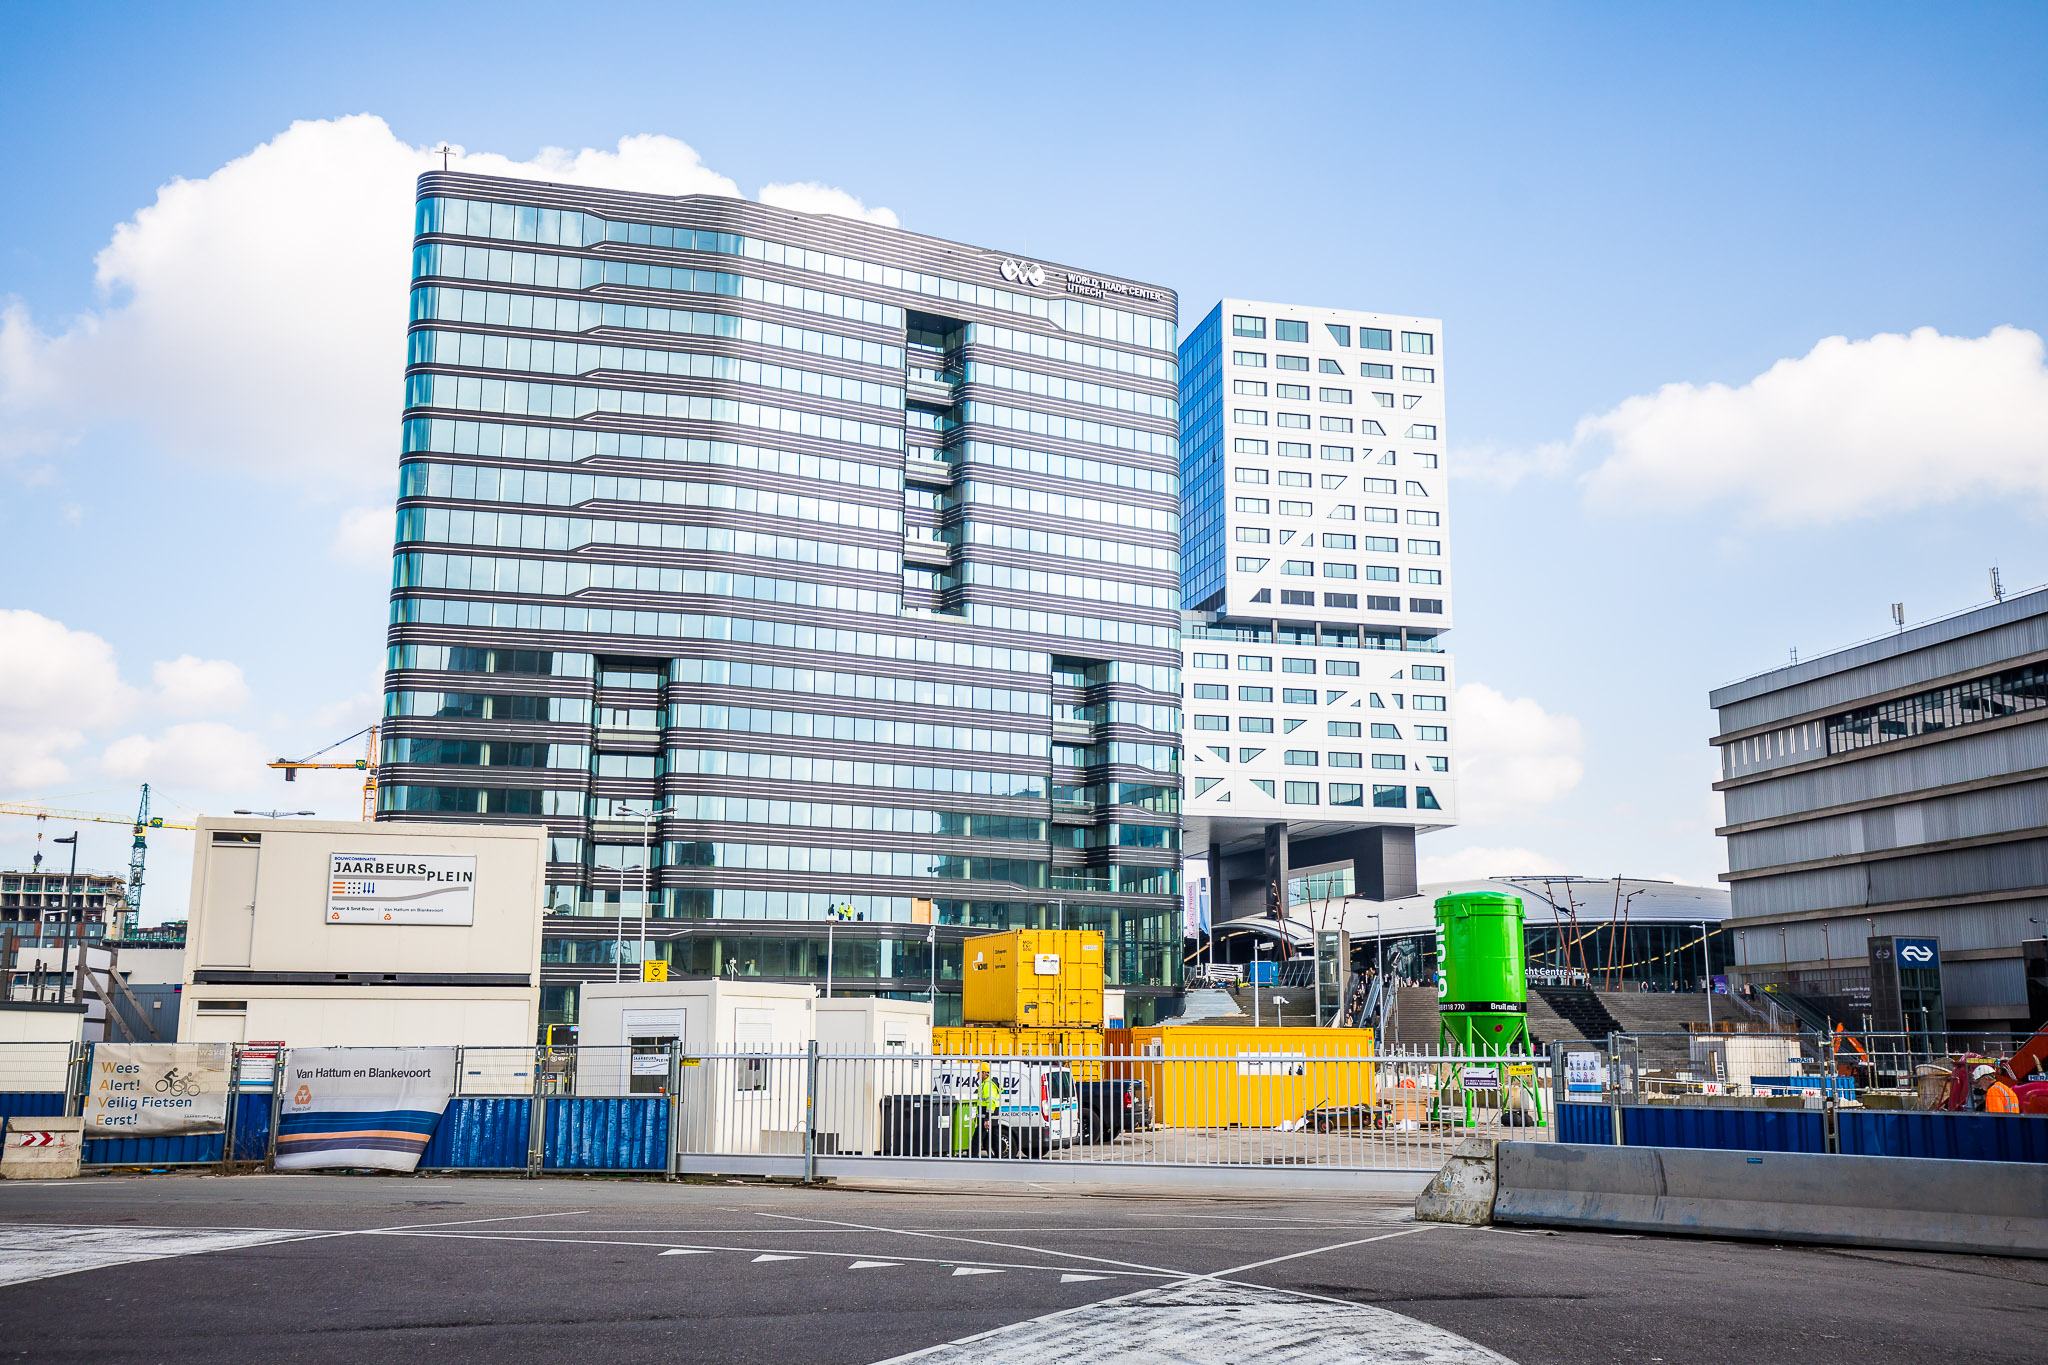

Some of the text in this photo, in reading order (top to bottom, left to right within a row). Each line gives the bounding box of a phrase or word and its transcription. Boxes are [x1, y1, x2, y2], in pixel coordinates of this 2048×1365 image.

[1066, 273, 1100, 288] WORLD
[1100, 280, 1128, 294] TRADE
[1067, 283, 1107, 298] UTRECHT
[102, 1062, 140, 1074] Wees
[296, 1069, 313, 1078] Van
[316, 1068, 350, 1077] Hattum
[368, 1068, 431, 1078] Blankevoort
[99, 1080, 140, 1091] Alert!
[1003, 1077, 1020, 1088] BV
[98, 1097, 192, 1110] Veilig Fietsen
[96, 1114, 138, 1125] Eerst!
